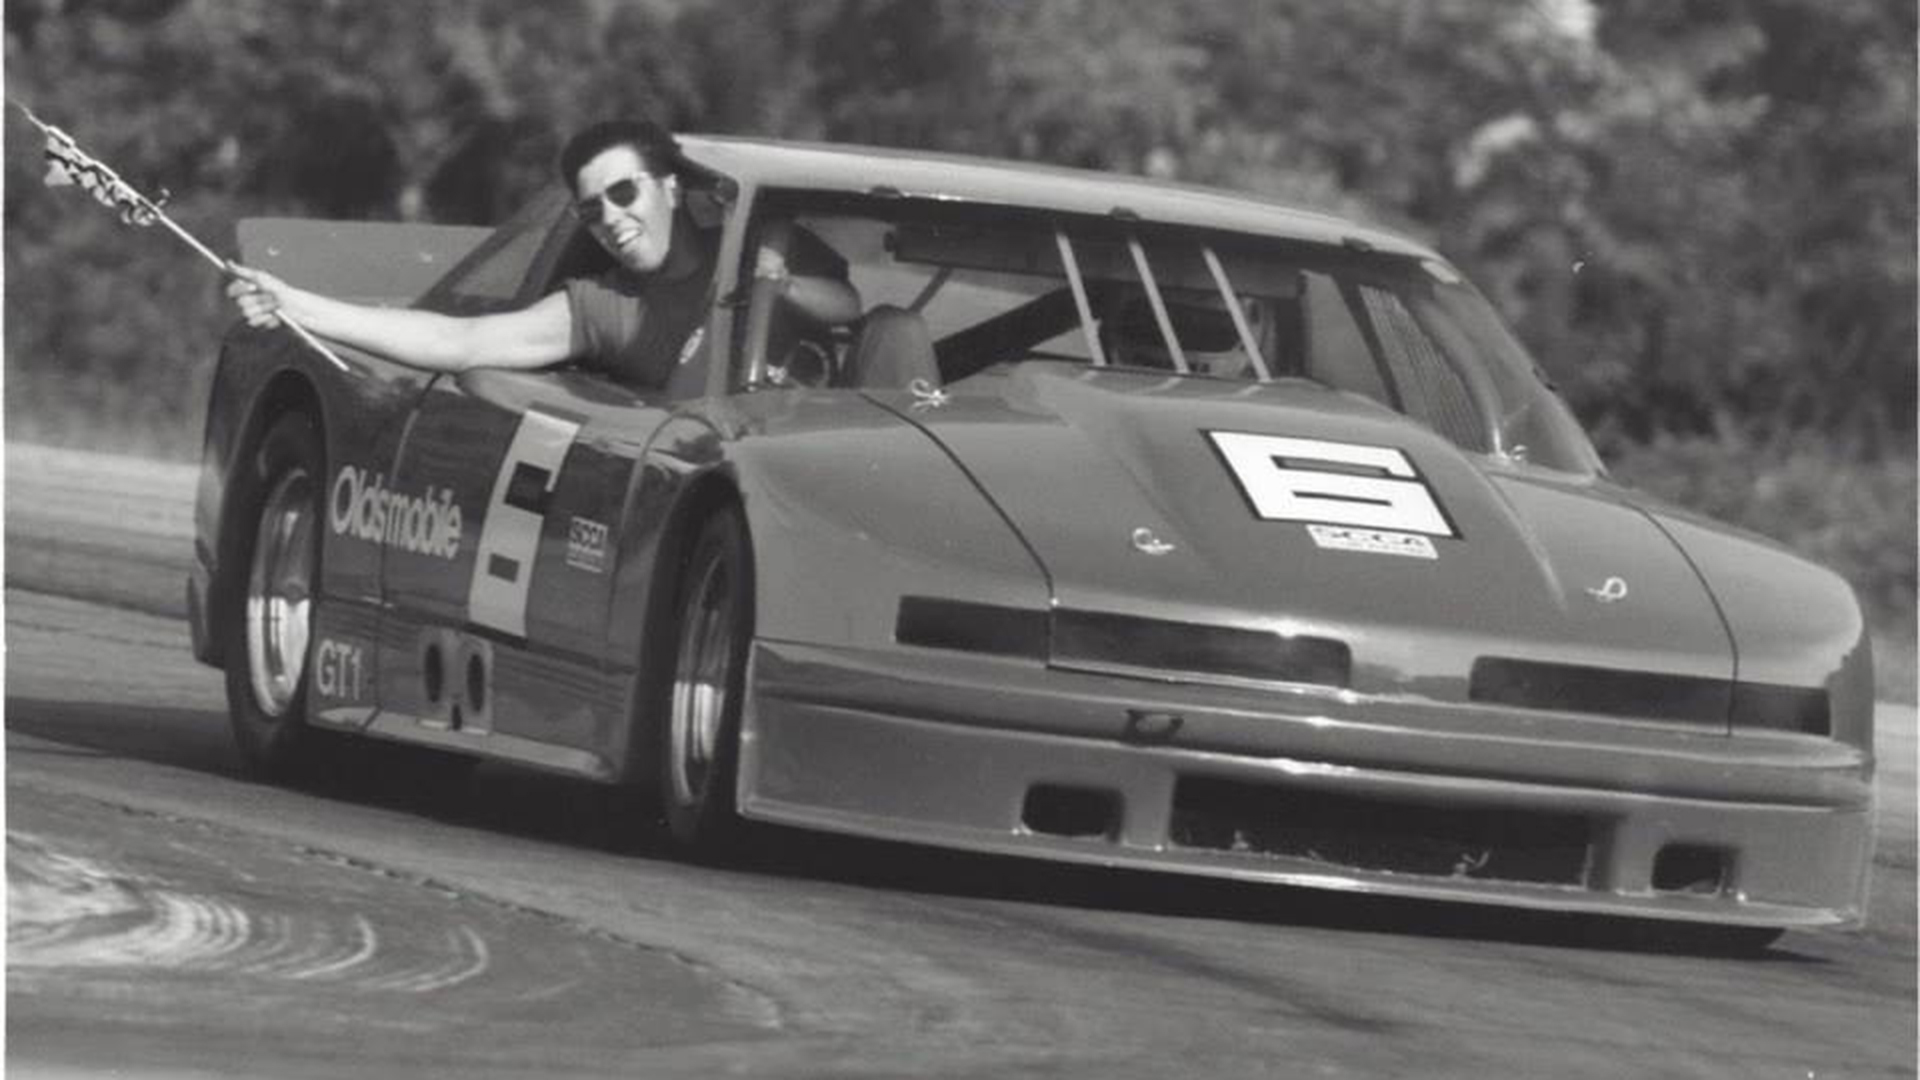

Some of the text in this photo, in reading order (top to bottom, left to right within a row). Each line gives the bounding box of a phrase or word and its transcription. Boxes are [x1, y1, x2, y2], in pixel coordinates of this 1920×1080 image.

[332, 465, 462, 559] Oldsmobile
[469, 410, 581, 637] 6
[1208, 430, 1453, 537] 6
[316, 639, 361, 700] GT1
